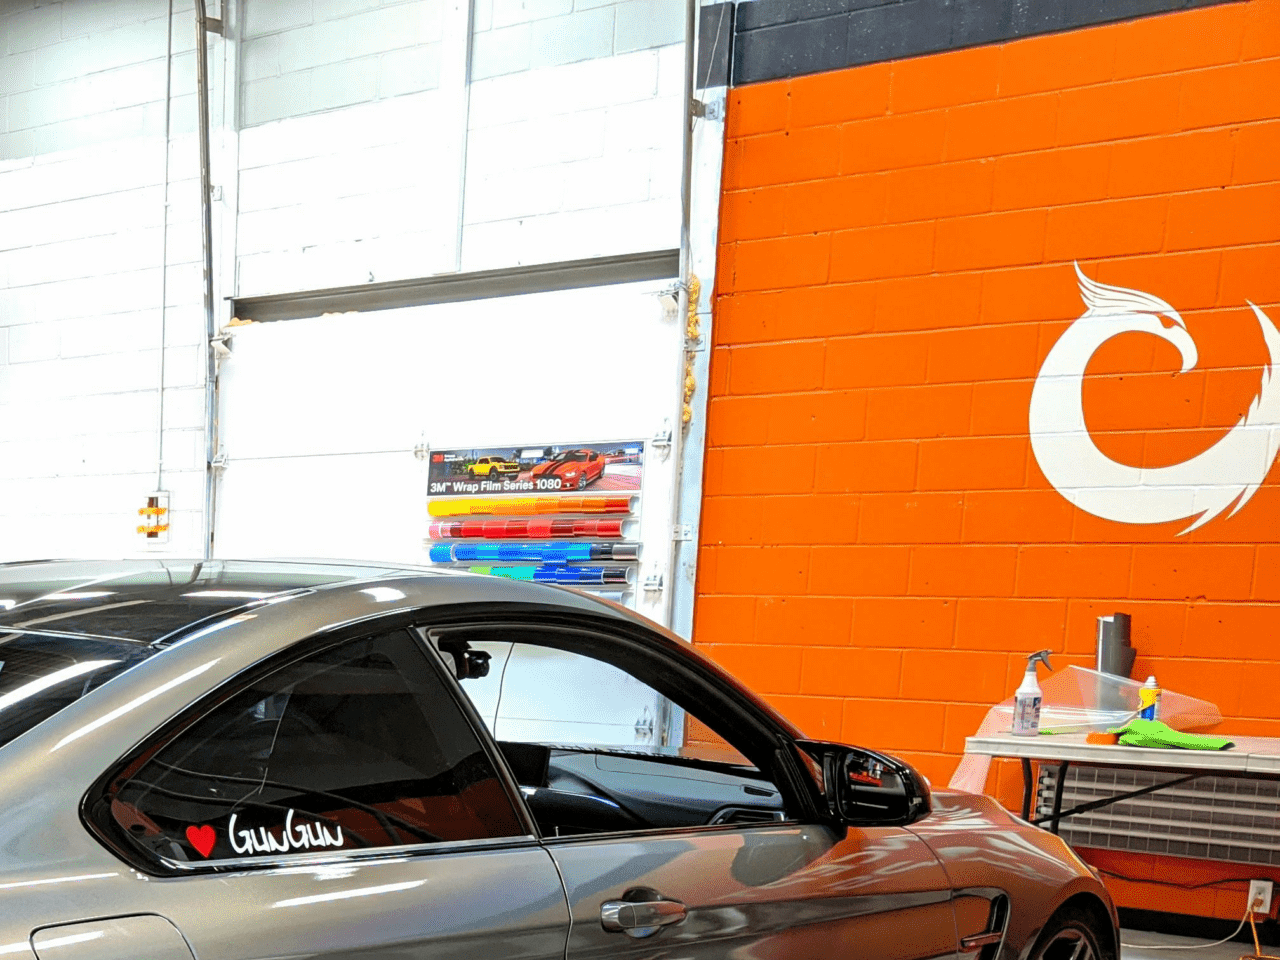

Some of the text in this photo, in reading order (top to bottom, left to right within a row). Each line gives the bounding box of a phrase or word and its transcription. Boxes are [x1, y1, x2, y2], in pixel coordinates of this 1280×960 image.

[453, 481, 478, 494] Wrap
[480, 480, 502, 492] Film
[503, 480, 534, 491] Series
[536, 478, 562, 490] 1080
